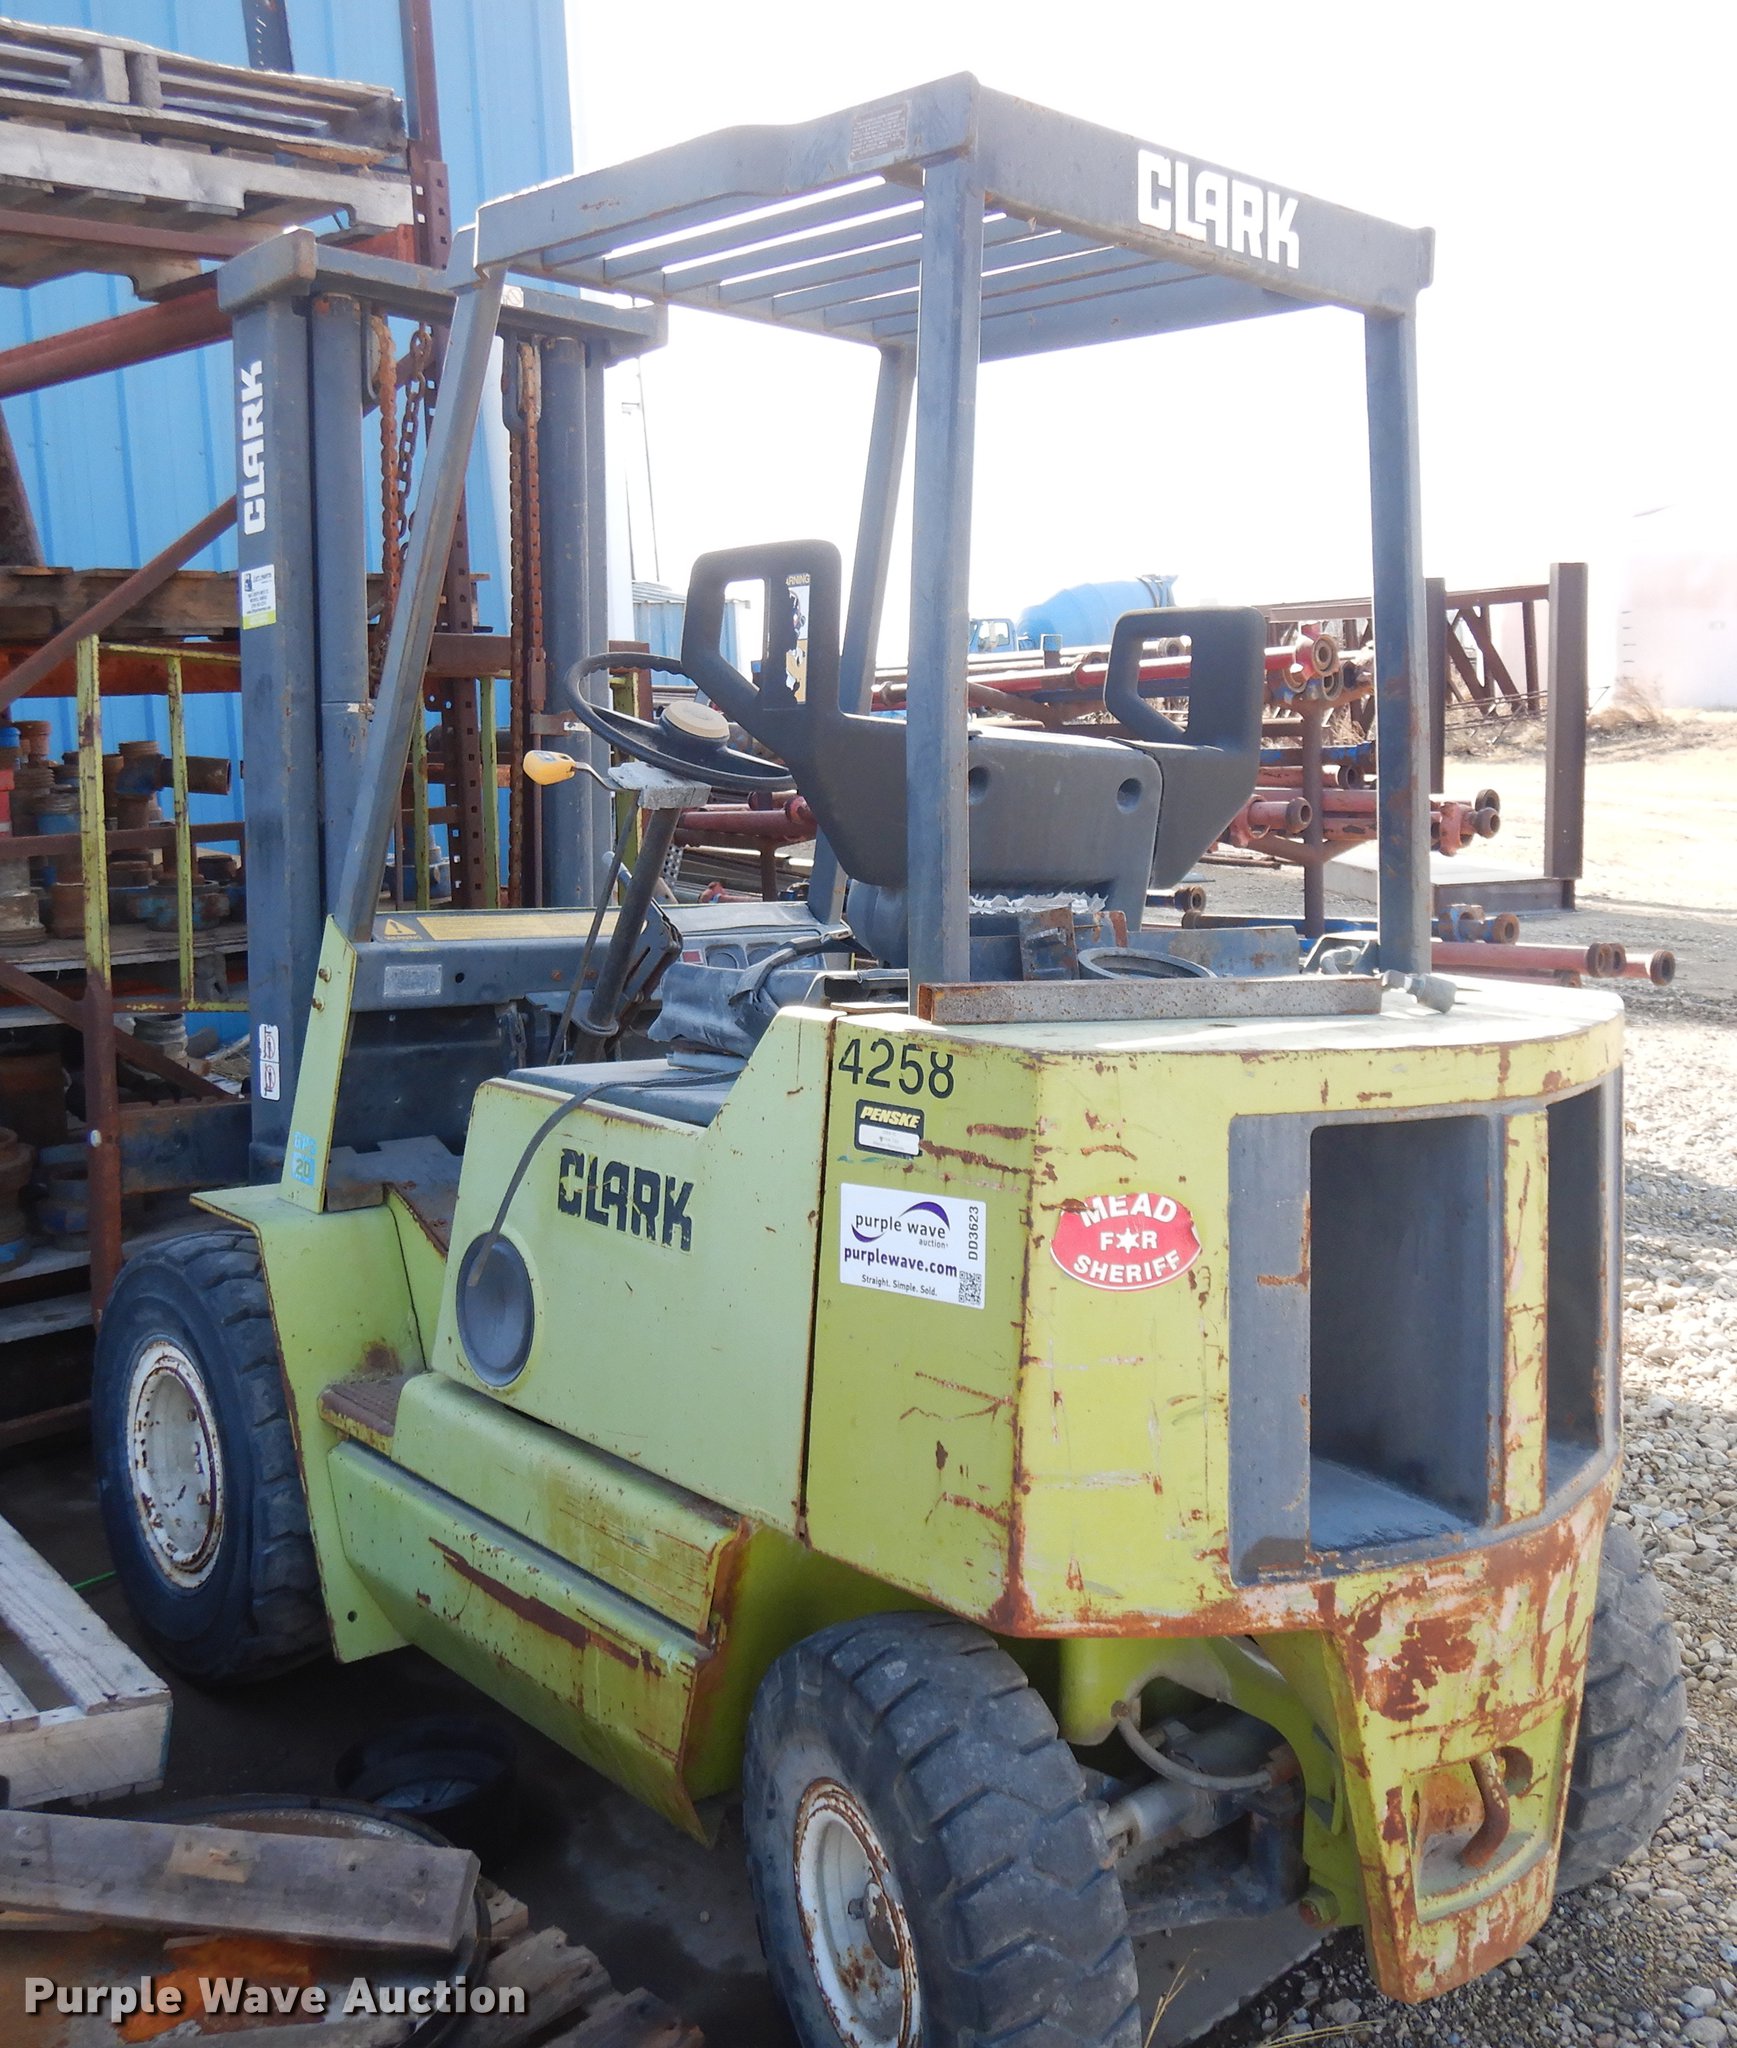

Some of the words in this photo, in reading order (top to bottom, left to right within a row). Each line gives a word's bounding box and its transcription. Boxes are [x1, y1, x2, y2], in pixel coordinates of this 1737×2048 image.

[1137, 148, 1300, 270] CLARK
[240, 360, 266, 536] CLARK
[838, 1037, 955, 1099] 4258
[860, 1105, 921, 1129] PENSKE
[557, 1147, 695, 1252] CLARK
[1080, 1192, 1178, 1228] MEAD
[855, 1214, 902, 1233] purple
[907, 1222, 946, 1239] wave
[968, 1205, 979, 1261] DD3623
[844, 1247, 958, 1278] purplewave.com
[1073, 1249, 1181, 1284] SHERIFF
[861, 1273, 891, 1288] Straight.
[892, 1279, 919, 1293] Simple.
[920, 1285, 938, 1297] Sold.
